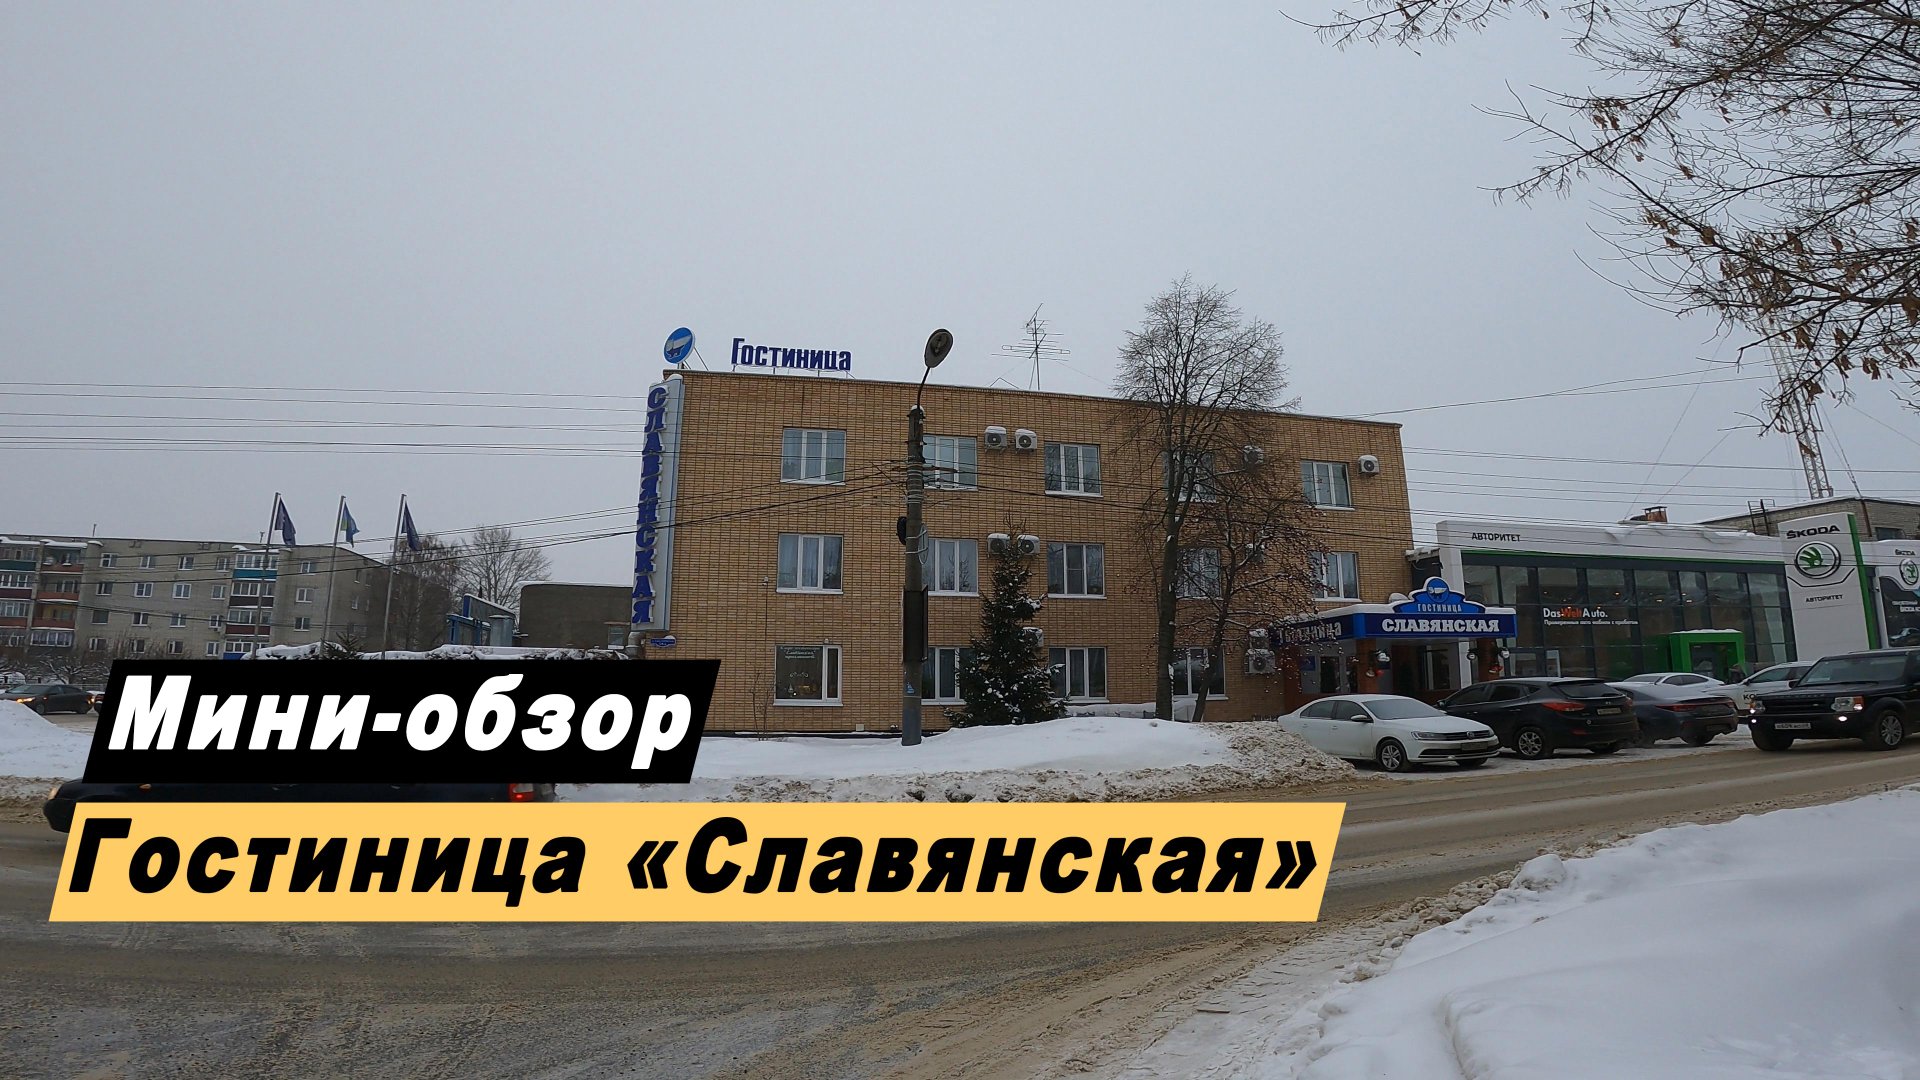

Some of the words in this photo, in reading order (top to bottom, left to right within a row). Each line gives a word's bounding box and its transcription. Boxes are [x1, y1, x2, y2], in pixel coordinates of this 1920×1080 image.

[731, 337, 851, 371] Гостиница
[632, 387, 668, 623] СЛАВЯНСКАЯ
[1472, 532, 1521, 542] АВТОРИТЕТ
[1787, 525, 1840, 539] ŠKODA
[1805, 594, 1843, 603] АВТОРИТЕТ
[1417, 603, 1462, 613] ГОСТИНИЦА
[1381, 618, 1500, 633] СЛАВЯНСКАЯ
